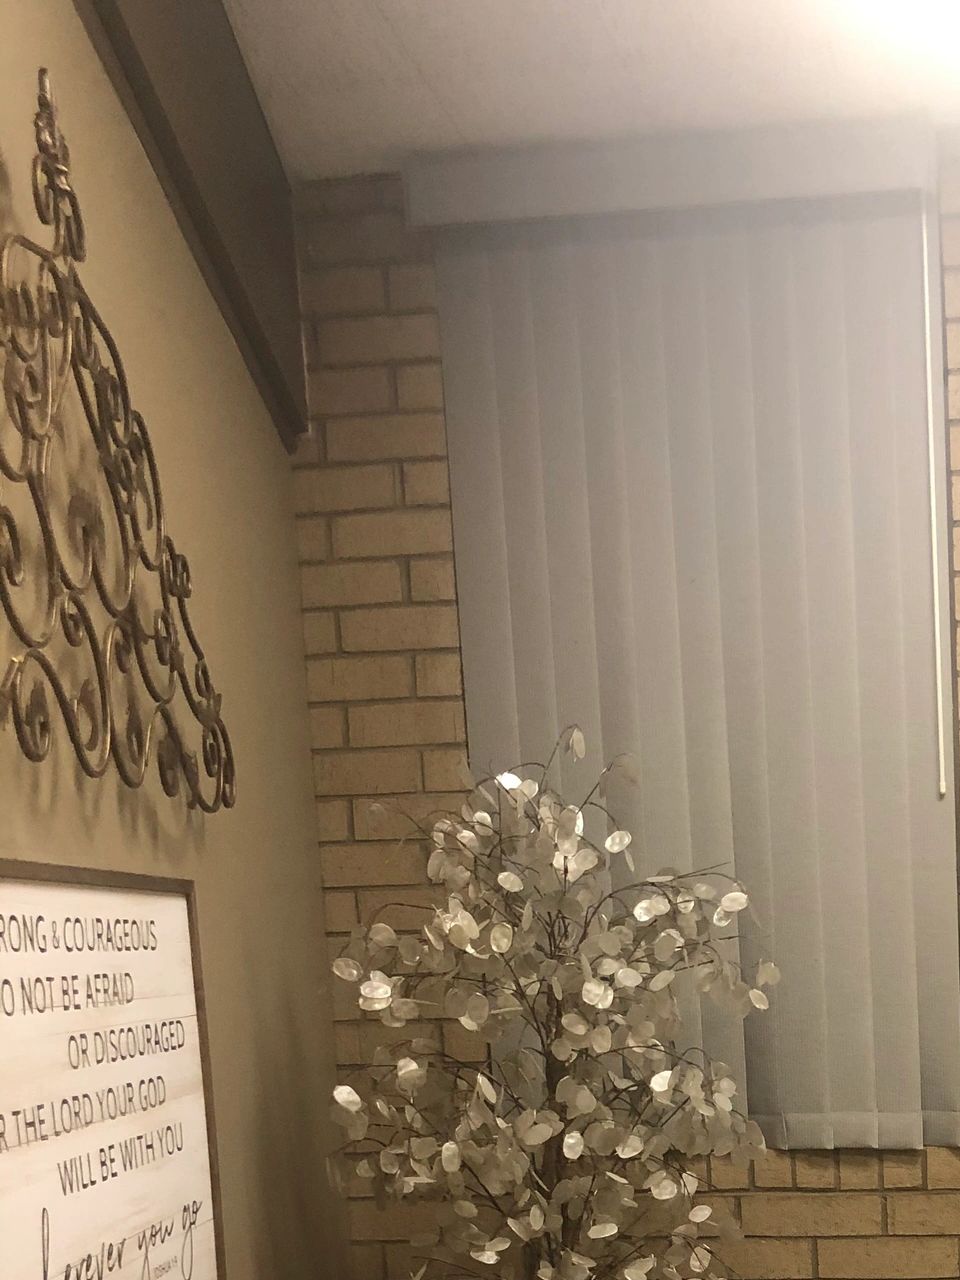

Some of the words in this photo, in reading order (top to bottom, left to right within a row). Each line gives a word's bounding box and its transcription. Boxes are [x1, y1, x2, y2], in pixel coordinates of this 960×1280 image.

[52, 920, 60, 949] &
[63, 917, 158, 952] COURAGEOUS
[20, 976, 55, 1016] NOT
[61, 975, 82, 1011] BE
[86, 972, 135, 1009] AFRAID
[67, 1035, 91, 1069] OR
[93, 1020, 186, 1065] DISCOURAGED
[12, 1104, 49, 1147] THE
[51, 1093, 94, 1137] LORD
[96, 1082, 137, 1123] YOUR
[139, 1075, 167, 1112] GOD
[57, 1152, 97, 1196] WILL
[99, 1144, 118, 1182] BE
[119, 1131, 156, 1173] WITH
[157, 1122, 184, 1159] YOU
